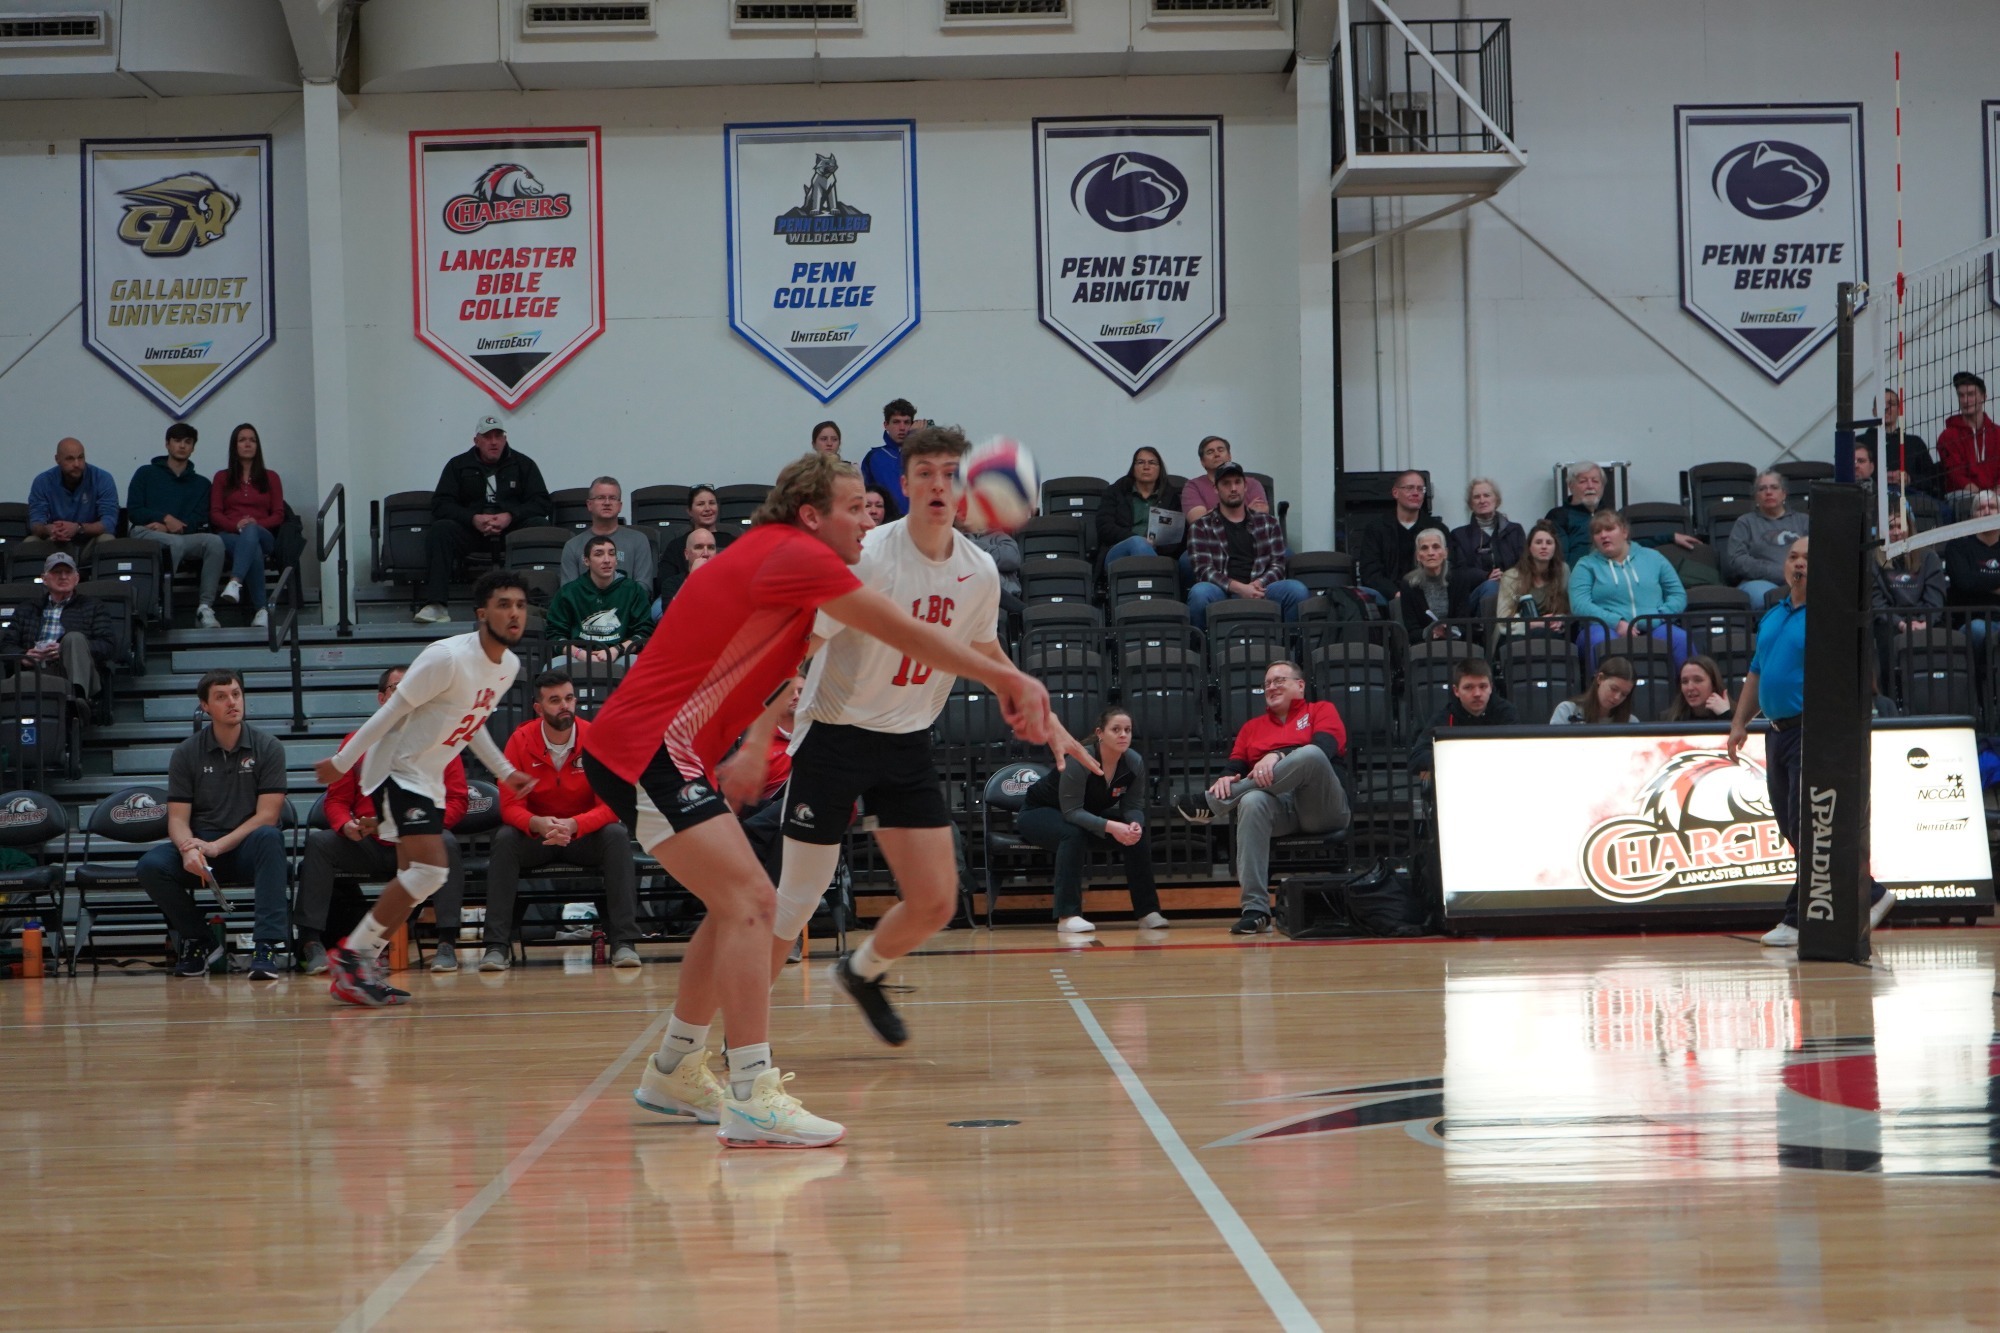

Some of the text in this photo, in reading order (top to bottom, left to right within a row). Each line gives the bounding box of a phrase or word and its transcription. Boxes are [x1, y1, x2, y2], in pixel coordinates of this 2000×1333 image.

[444, 194, 571, 233] CHARGERS
[776, 215, 869, 232] PENN COLLEGE
[117, 204, 197, 256] GU
[788, 232, 855, 243] WILDCATS
[439, 247, 577, 271] LANCASTER
[1060, 254, 1202, 278] PENN STATE
[1702, 243, 1845, 265] PENN STATE
[475, 271, 543, 295] BIBLE
[791, 261, 856, 284] PENN
[1734, 268, 1812, 290] BERKS
[110, 276, 248, 301] GALLAUDET
[773, 285, 877, 309] COLLEGE
[1072, 279, 1190, 303] ABINGTON
[107, 301, 252, 327] UNIVERSITY
[459, 296, 561, 321] COLLEGE
[912, 595, 955, 627] LBC
[1917, 788, 1966, 800] NCCAA
[1588, 819, 1797, 892] CHARGE
[1806, 786, 1837, 921] SPALDING
[1678, 867, 1744, 885] LANCASTER
[1745, 864, 1777, 877] BIBLE
